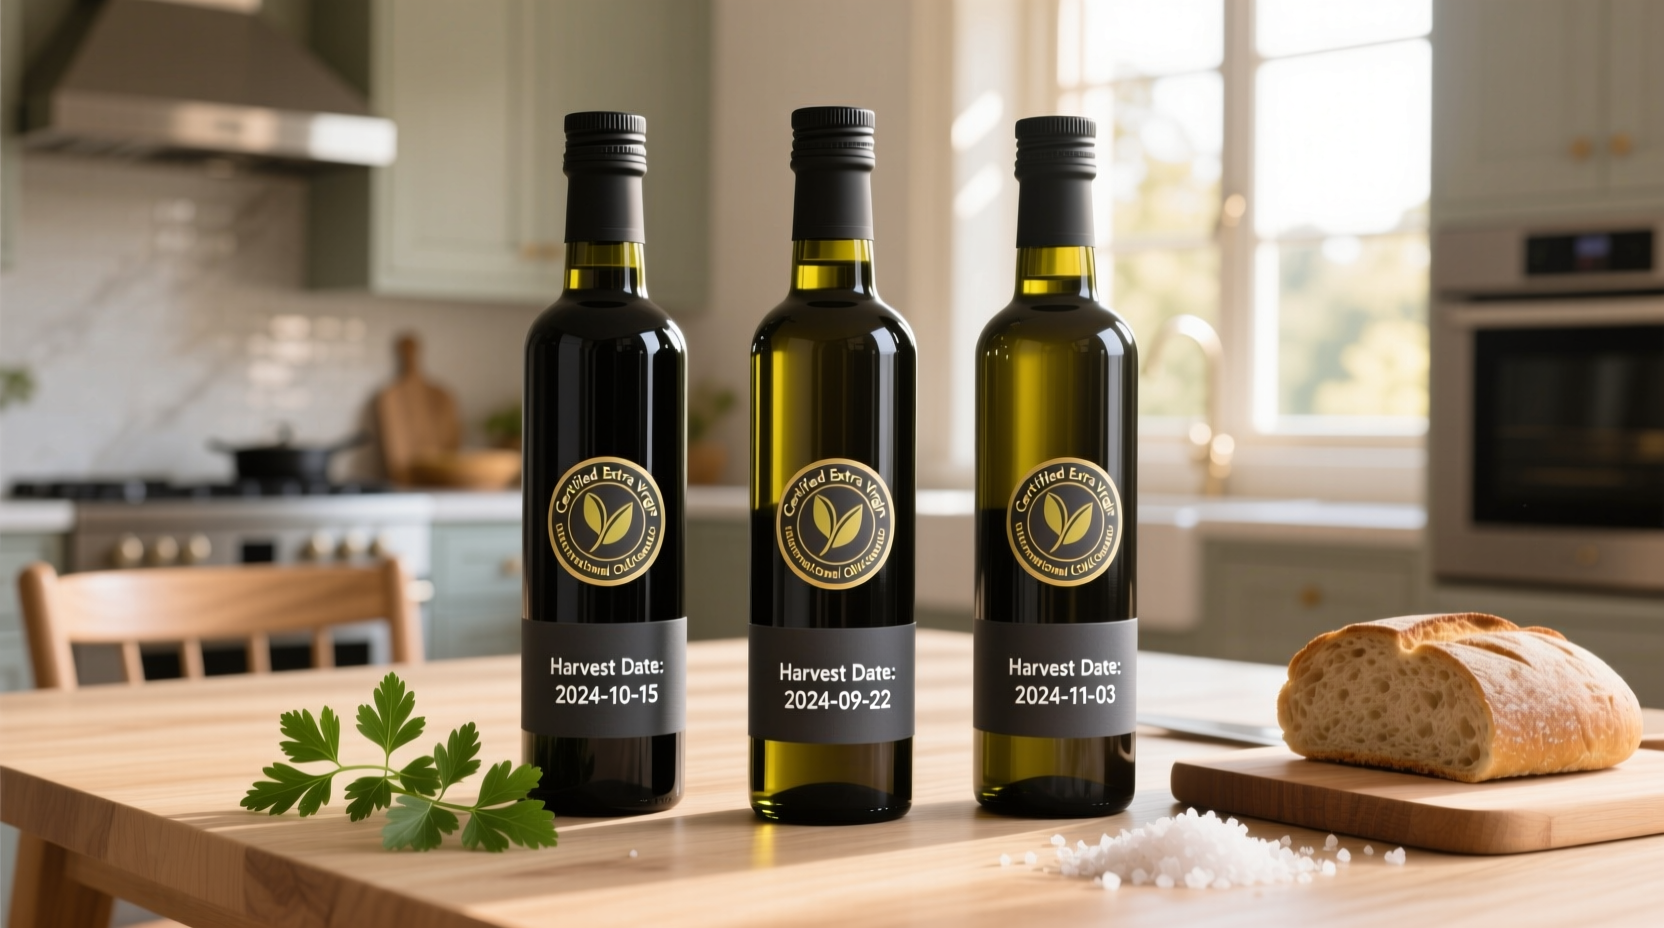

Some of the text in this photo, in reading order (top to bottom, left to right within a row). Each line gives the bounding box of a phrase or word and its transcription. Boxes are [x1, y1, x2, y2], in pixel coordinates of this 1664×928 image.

[550, 657, 664, 676] Harvest Date:
[780, 662, 896, 682] Harvest Date:
[1009, 658, 1121, 677] Harvest Date:
[555, 684, 659, 705] 2024-10-15
[784, 689, 891, 710] 2024-09-22
[1015, 684, 1116, 705] 2024-11-03
